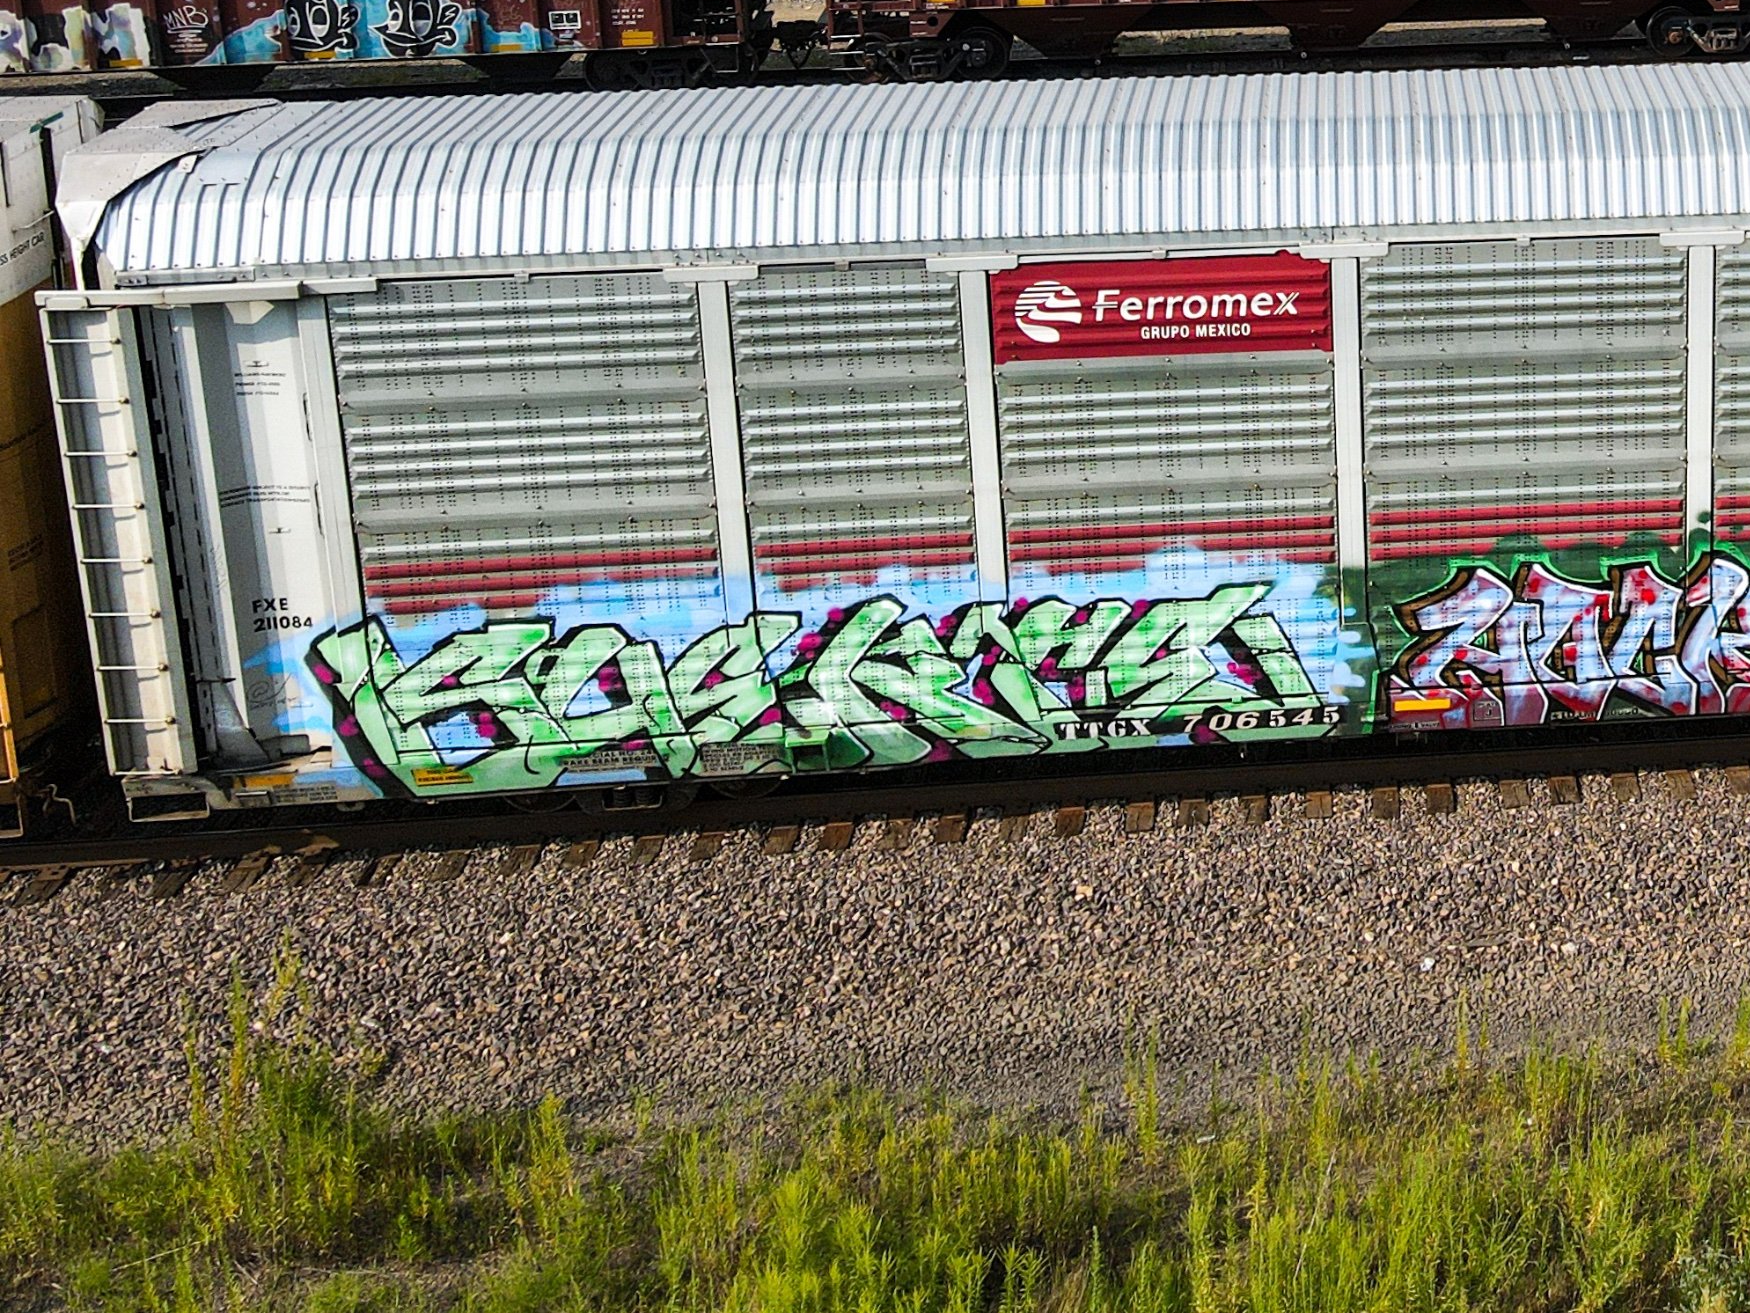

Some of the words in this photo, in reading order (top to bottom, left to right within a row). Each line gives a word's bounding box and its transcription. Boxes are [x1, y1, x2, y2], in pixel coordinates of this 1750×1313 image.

[30, 231, 45, 249] CAR
[1091, 288, 1300, 322] Ferromex
[1140, 324, 1190, 340] GRUPO
[1195, 322, 1251, 338] MEXICO
[252, 597, 288, 614] FXE
[253, 614, 313, 633] 211084
[1059, 716, 1151, 740] TTGX
[1182, 705, 1341, 733] 706545
